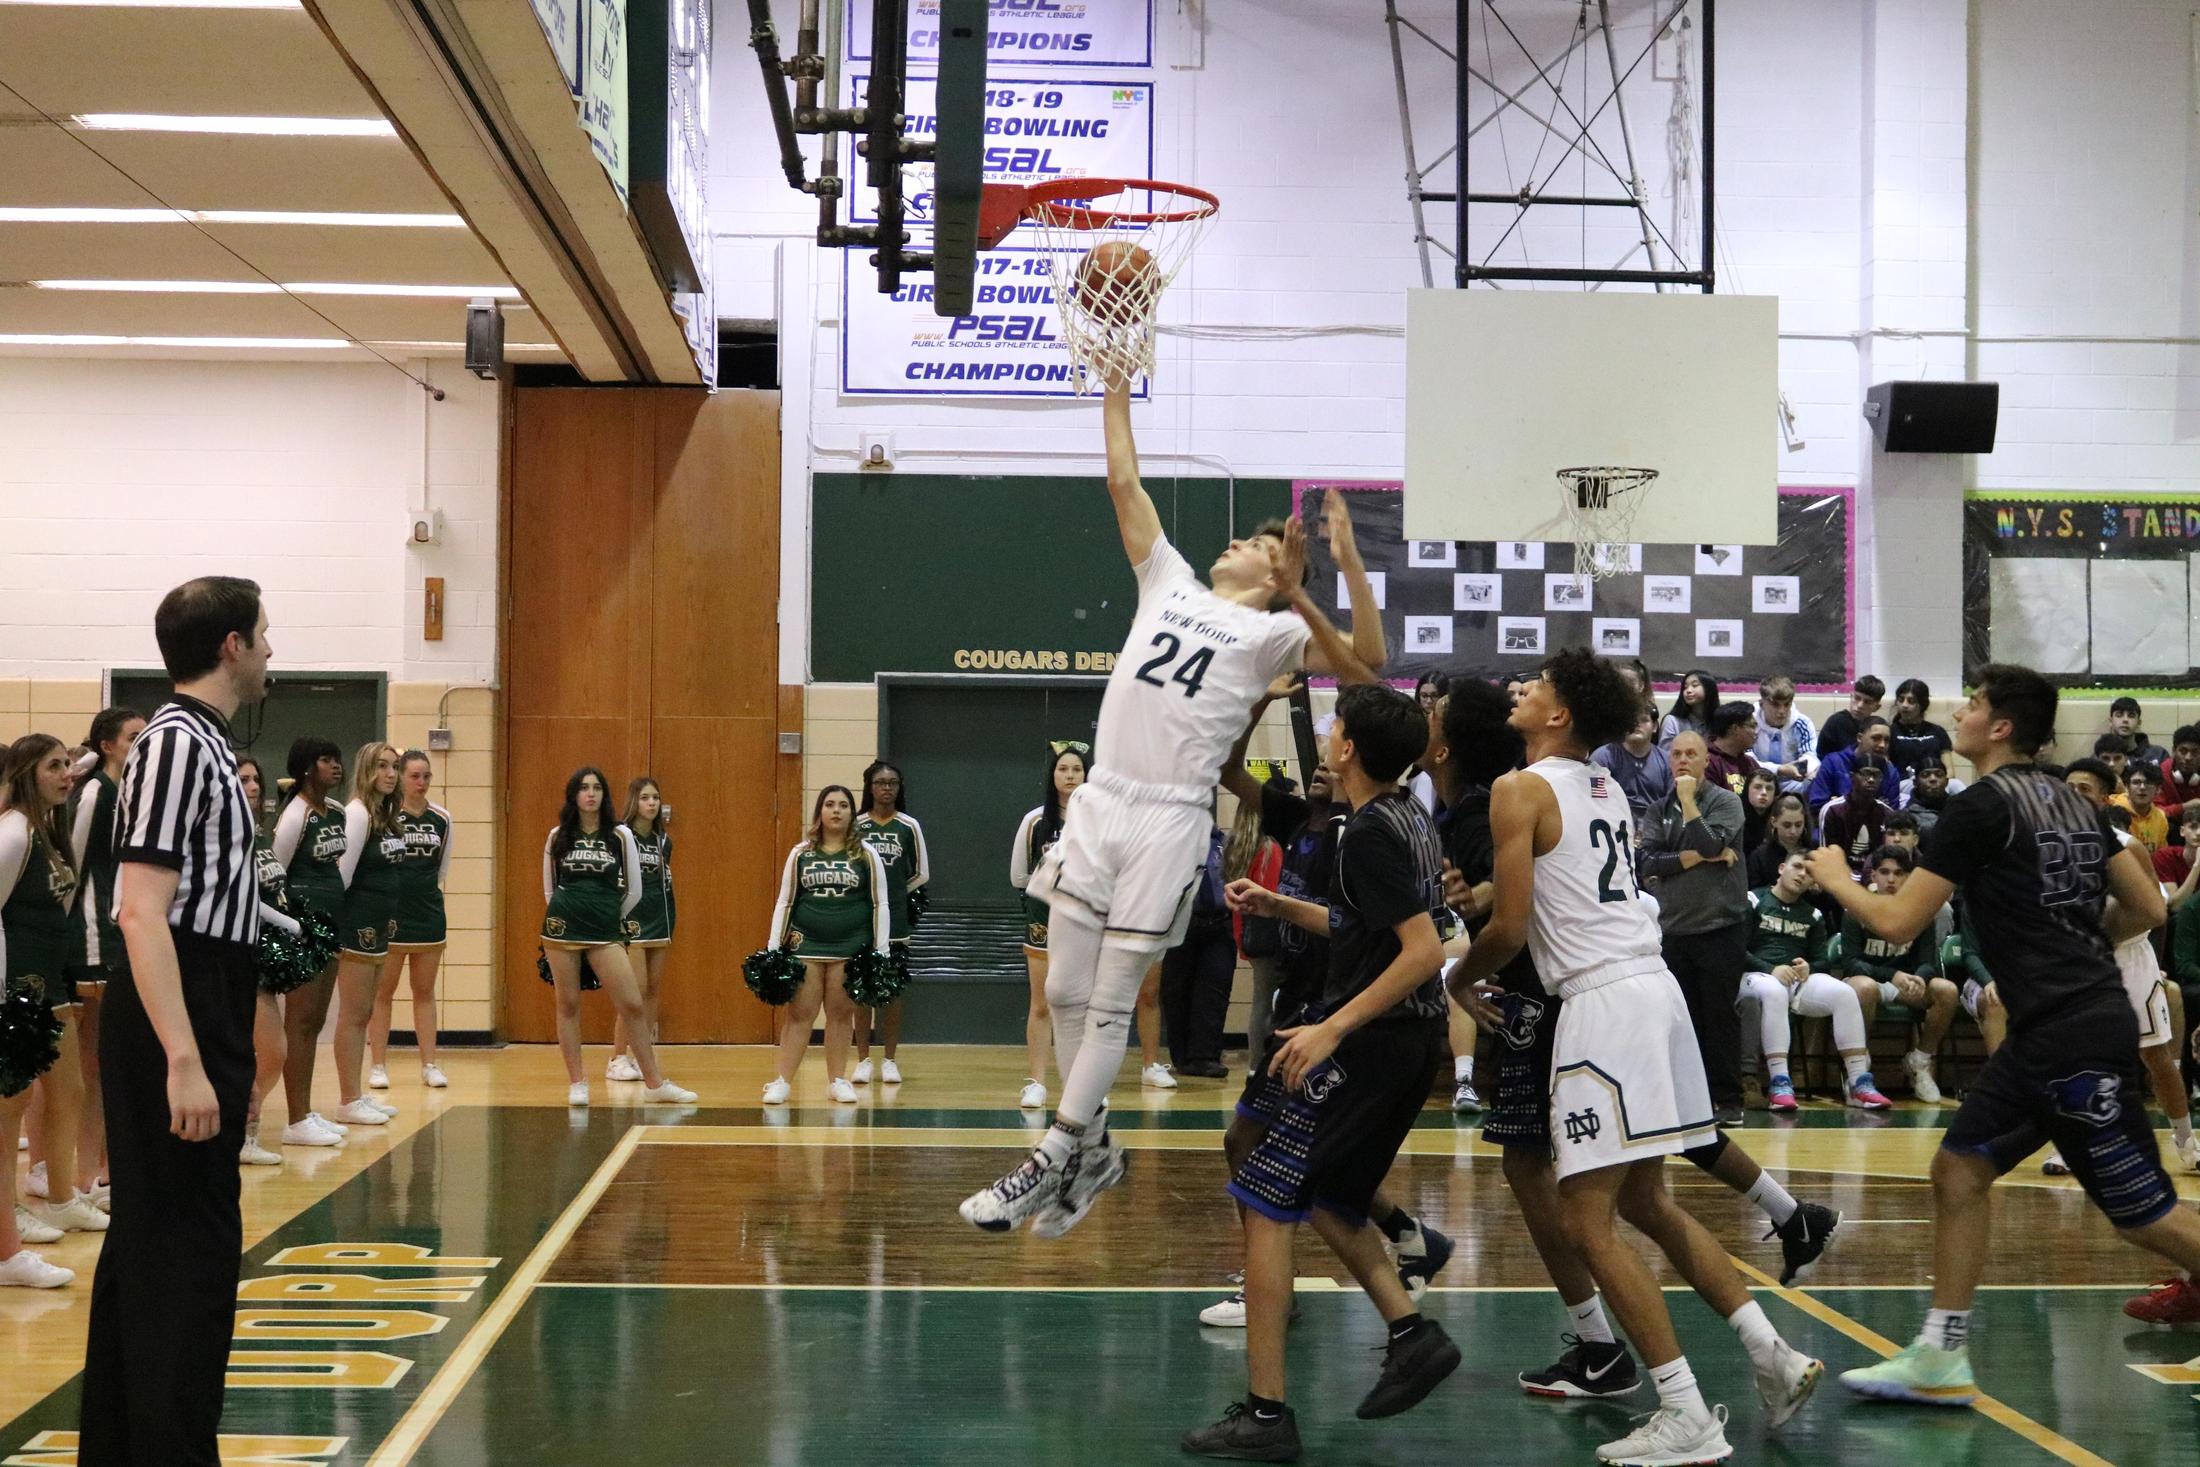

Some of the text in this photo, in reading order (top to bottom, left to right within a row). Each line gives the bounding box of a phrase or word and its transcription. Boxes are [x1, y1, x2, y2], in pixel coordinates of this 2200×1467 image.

[910, 30, 1092, 51] CPIONS
[985, 90, 1063, 109] 18-19
[1112, 90, 1144, 101] NYC
[904, 115, 1109, 138] GIR BOWLING
[975, 258, 1053, 276] 17-18
[890, 284, 934, 303] GIR
[949, 341, 991, 349] SCHOOLS
[905, 362, 1087, 381] CHAMPIONS
[1996, 507, 2084, 538] N.Y.S.
[1159, 610, 1194, 629] NEW
[954, 649, 1069, 671] COUGARS
[1135, 631, 1216, 698] 24
[1590, 819, 1640, 903] 21
[801, 871, 860, 889] COUGARS
